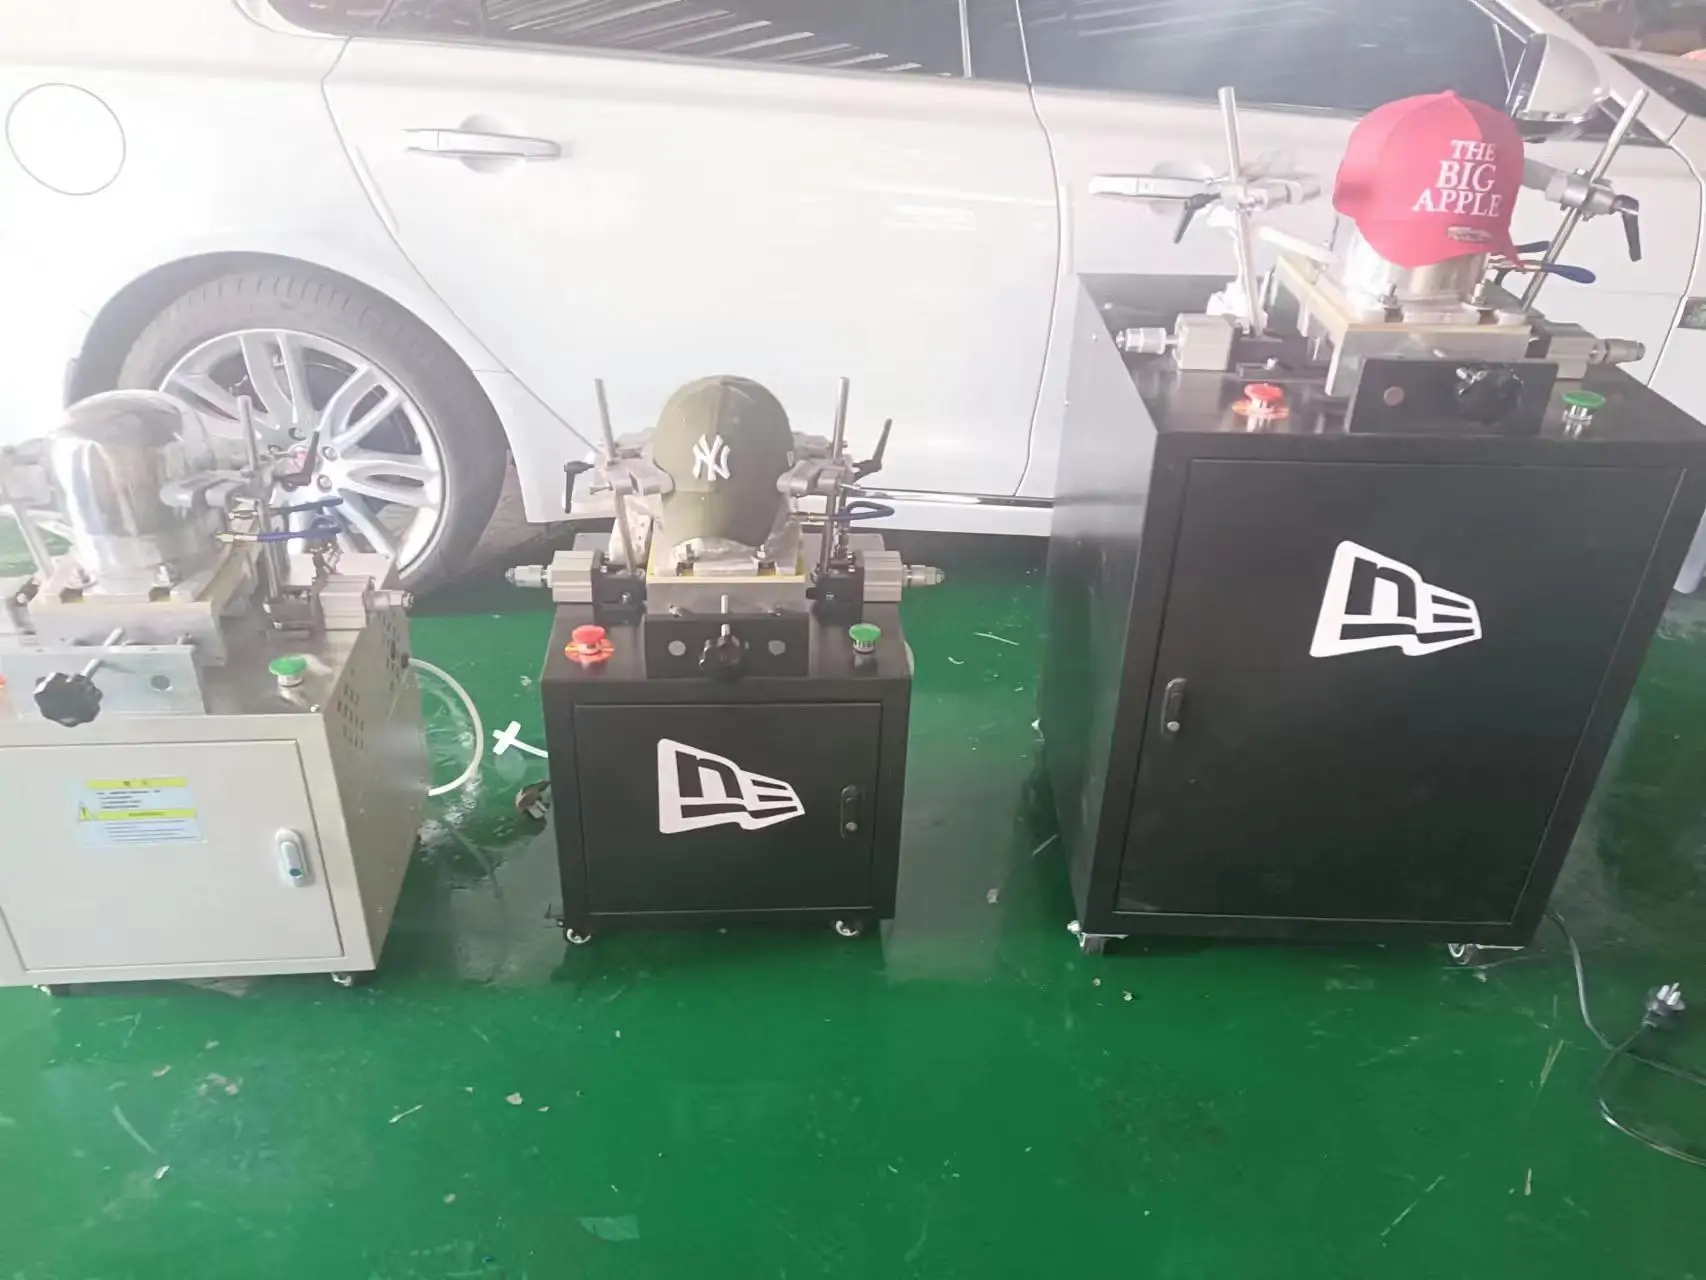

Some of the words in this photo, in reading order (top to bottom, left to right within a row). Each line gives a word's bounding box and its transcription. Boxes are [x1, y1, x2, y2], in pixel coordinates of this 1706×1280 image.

[1450, 139, 1496, 161] THE
[1436, 160, 1497, 191] BIG
[1411, 188, 1502, 217] APPLE
